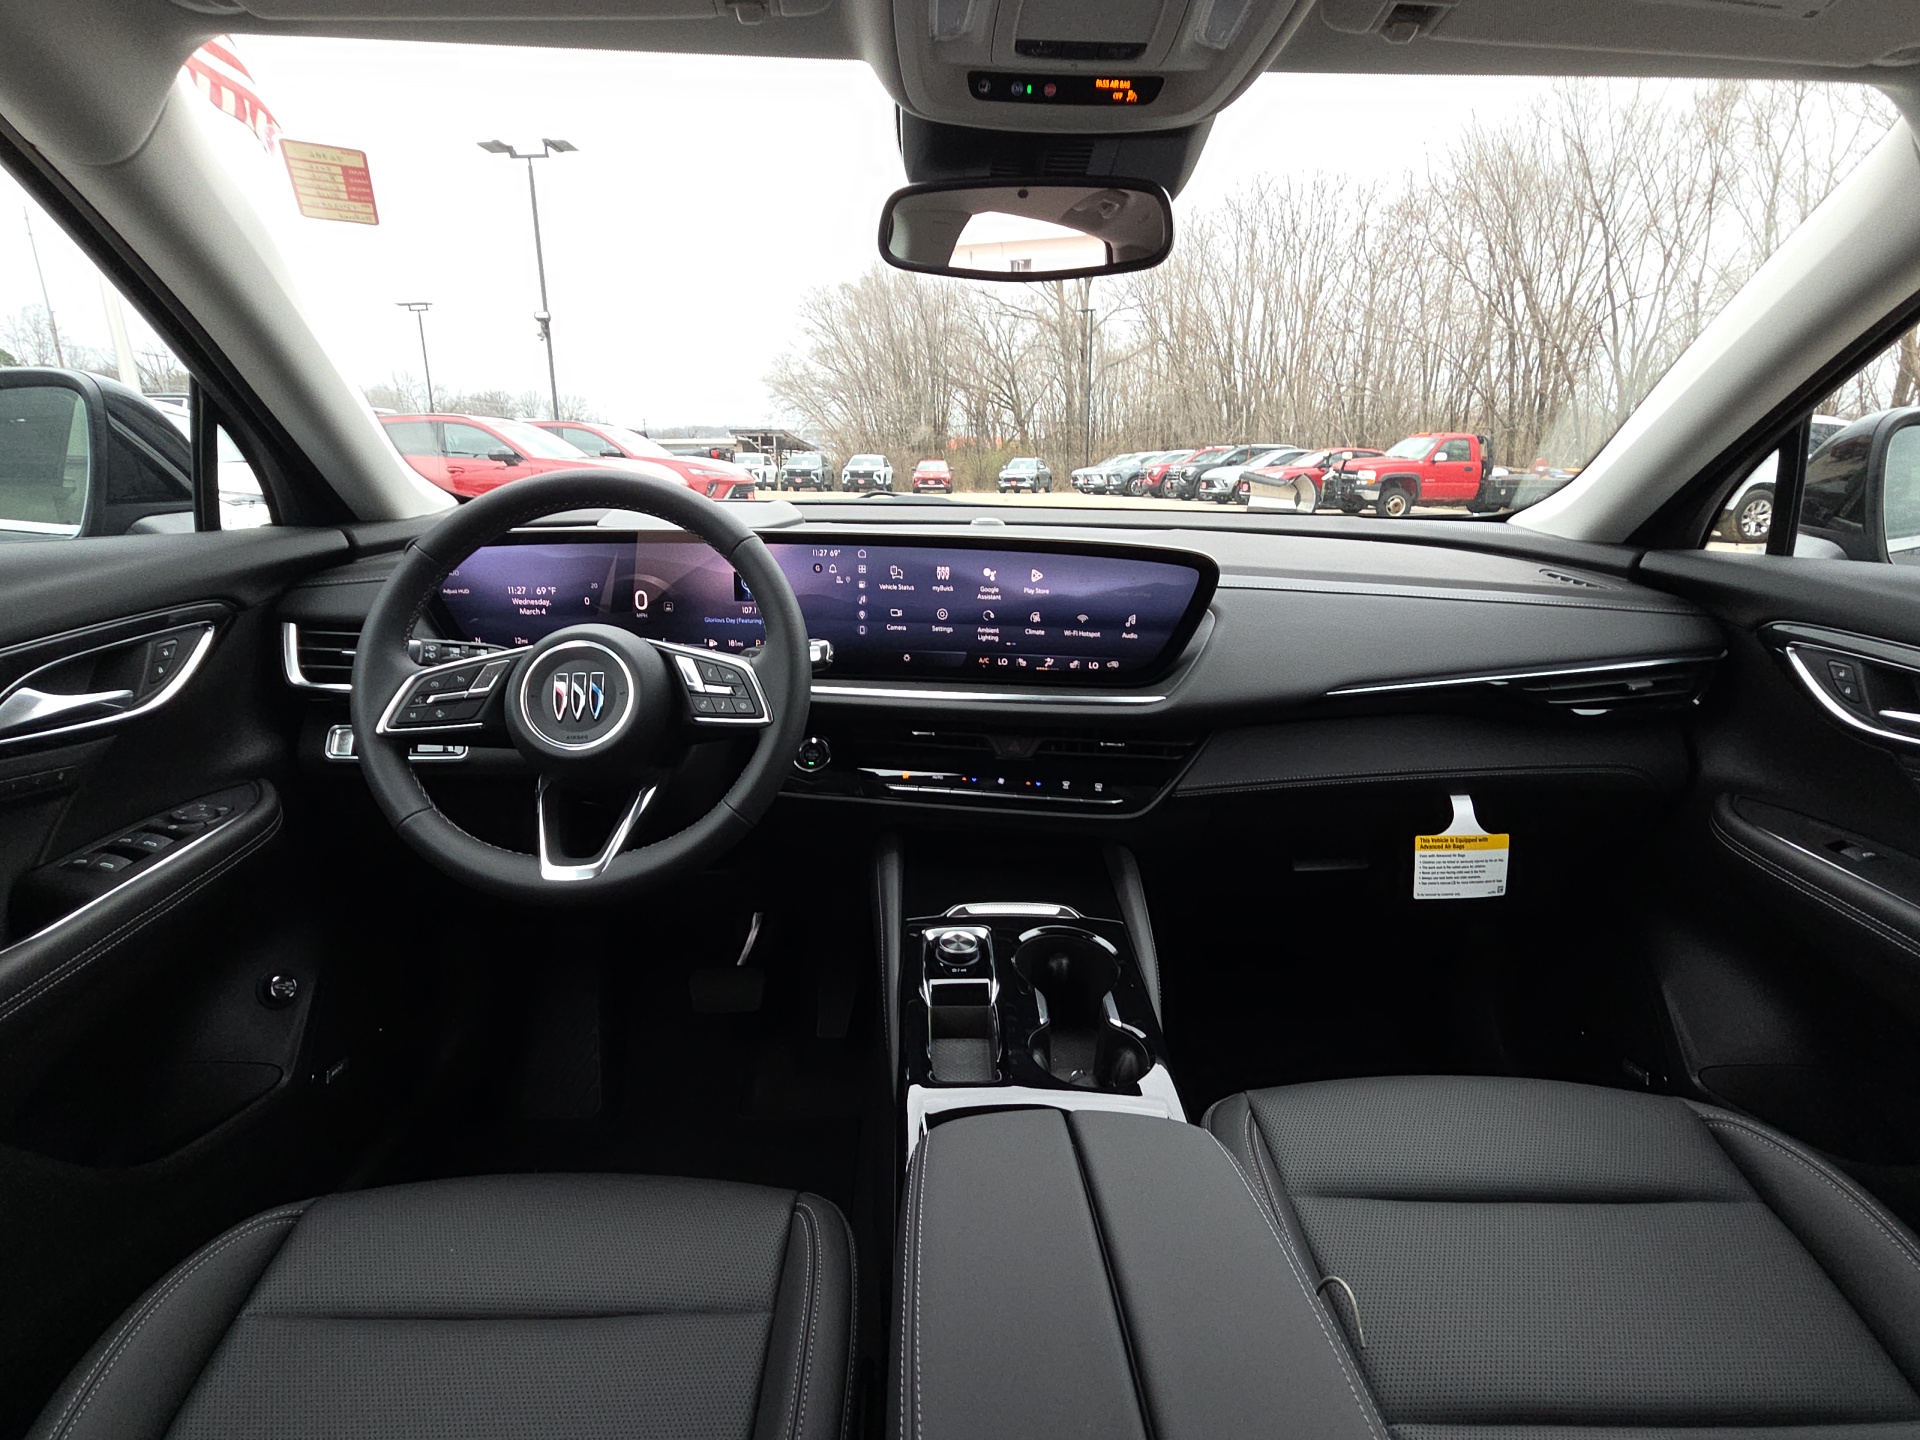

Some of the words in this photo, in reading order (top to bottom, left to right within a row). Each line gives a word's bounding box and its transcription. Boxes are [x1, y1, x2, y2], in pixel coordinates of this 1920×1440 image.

[1110, 80, 1119, 88] AIR
[508, 586, 526, 595] 11:27
[536, 587, 546, 595] 69
[980, 586, 999, 594] Google
[584, 597, 590, 605] 0
[634, 589, 648, 610] 0
[742, 606, 757, 614] 107.1
[932, 625, 953, 633] Settings
[978, 634, 999, 642] Lighting
[1079, 630, 1100, 638] Hotspot
